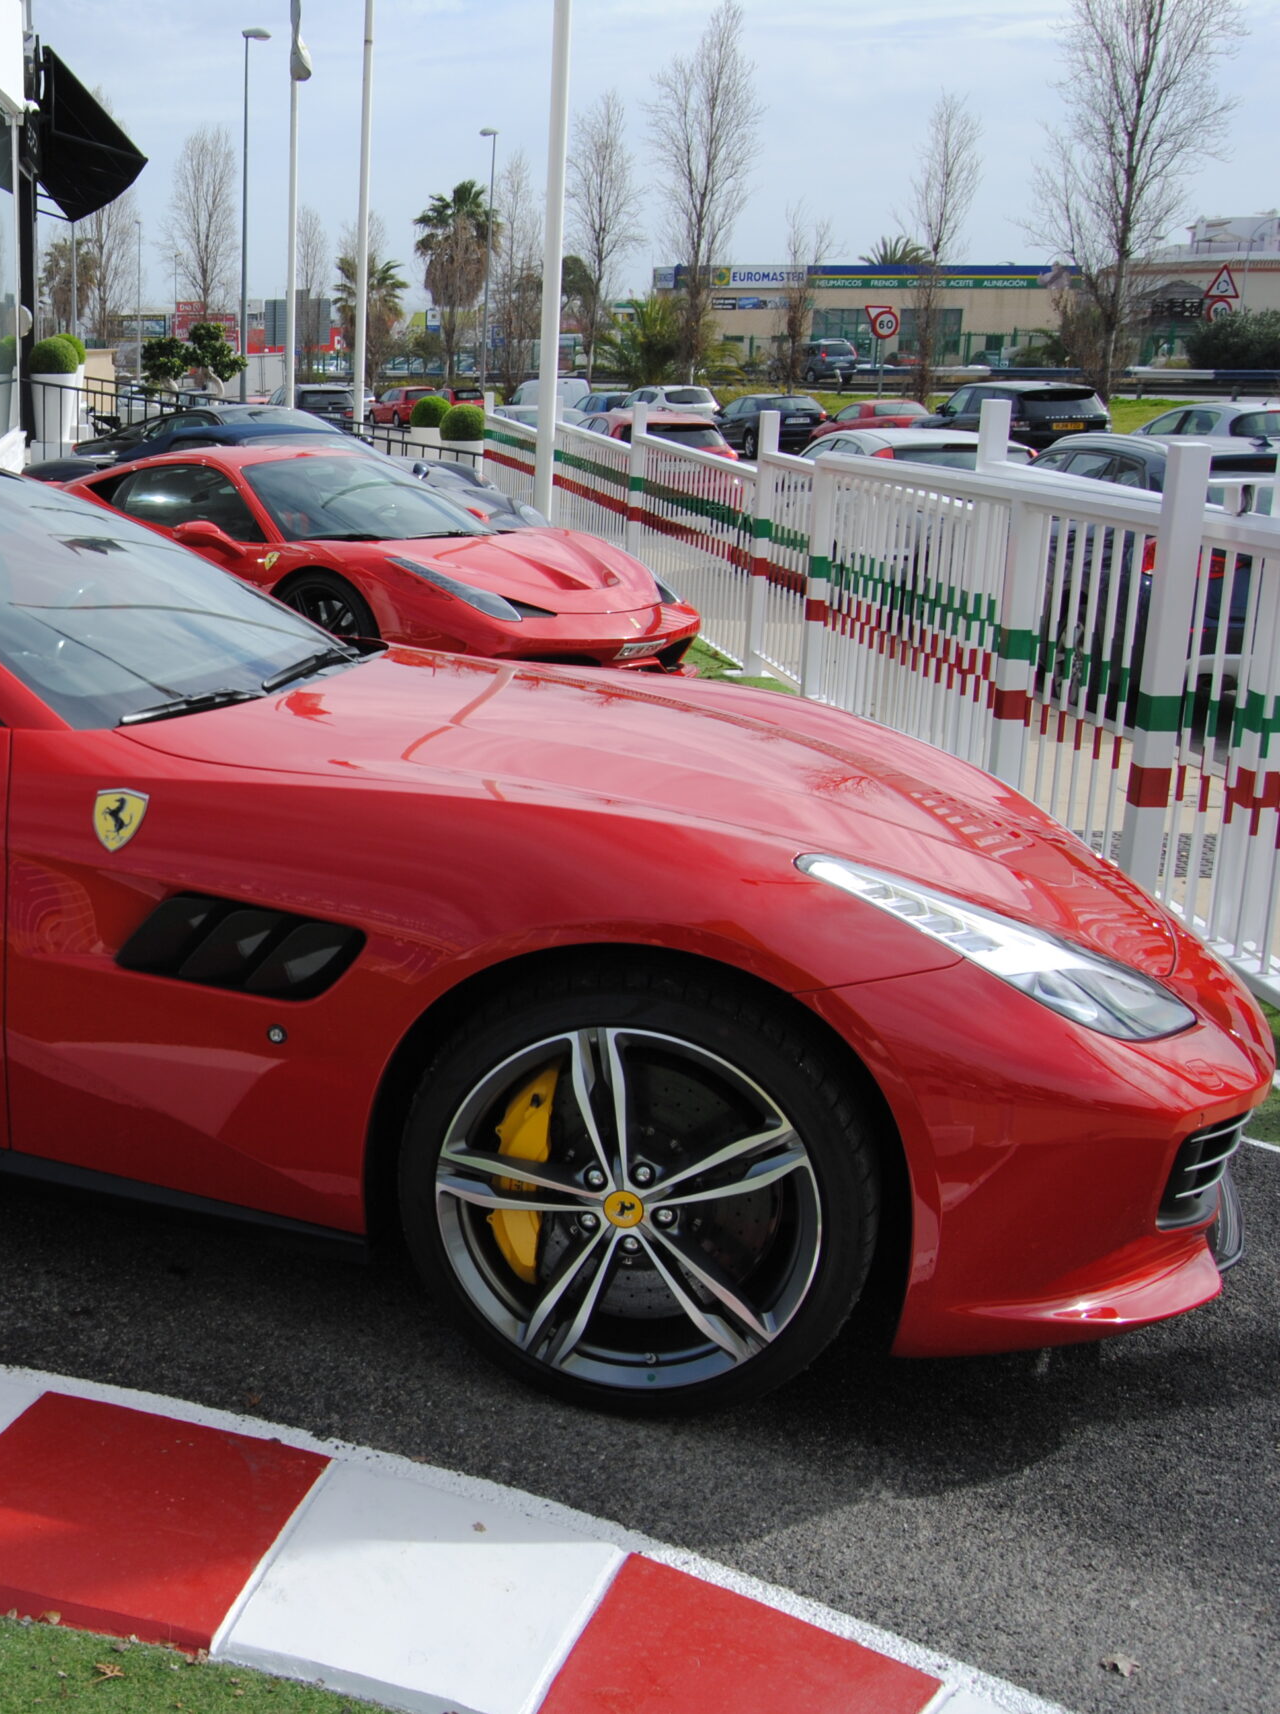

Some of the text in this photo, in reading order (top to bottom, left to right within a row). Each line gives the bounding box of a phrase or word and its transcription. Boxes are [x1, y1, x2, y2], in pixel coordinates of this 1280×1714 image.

[732, 271, 805, 282] EUROMASTER
[870, 279, 899, 287] FRENOS
[948, 279, 974, 287] ACEITE
[982, 278, 1028, 287] ALINEACIÓN
[878, 319, 894, 330] 60
